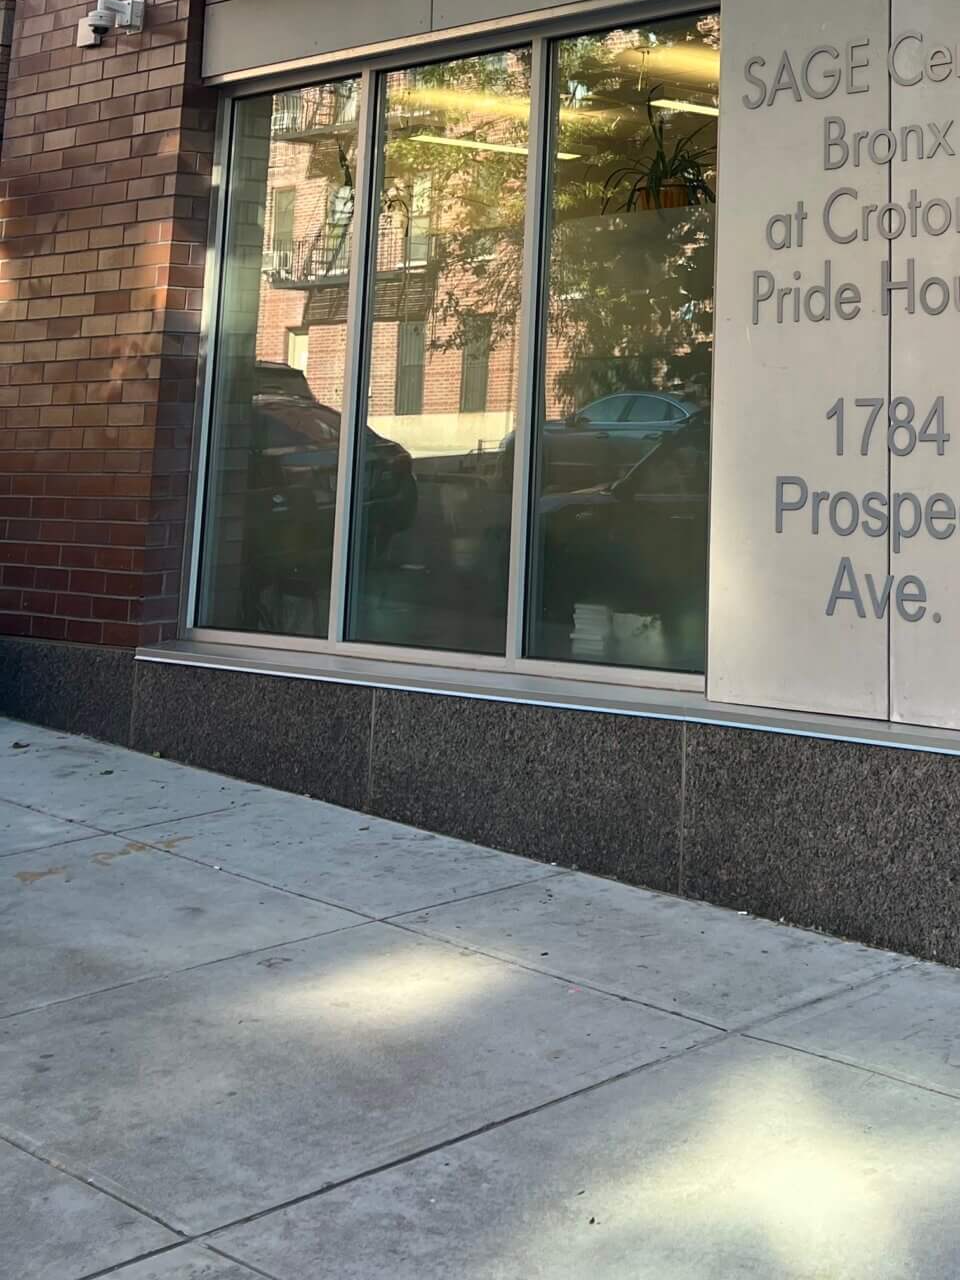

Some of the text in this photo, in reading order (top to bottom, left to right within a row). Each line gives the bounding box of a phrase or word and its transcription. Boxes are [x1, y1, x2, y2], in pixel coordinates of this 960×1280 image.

[742, 38, 870, 109] SAGE
[823, 115, 956, 170] Bronx
[766, 200, 808, 250] at
[751, 259, 861, 325] Pride
[826, 395, 950, 457] 1784
[825, 556, 942, 624] Ave.
